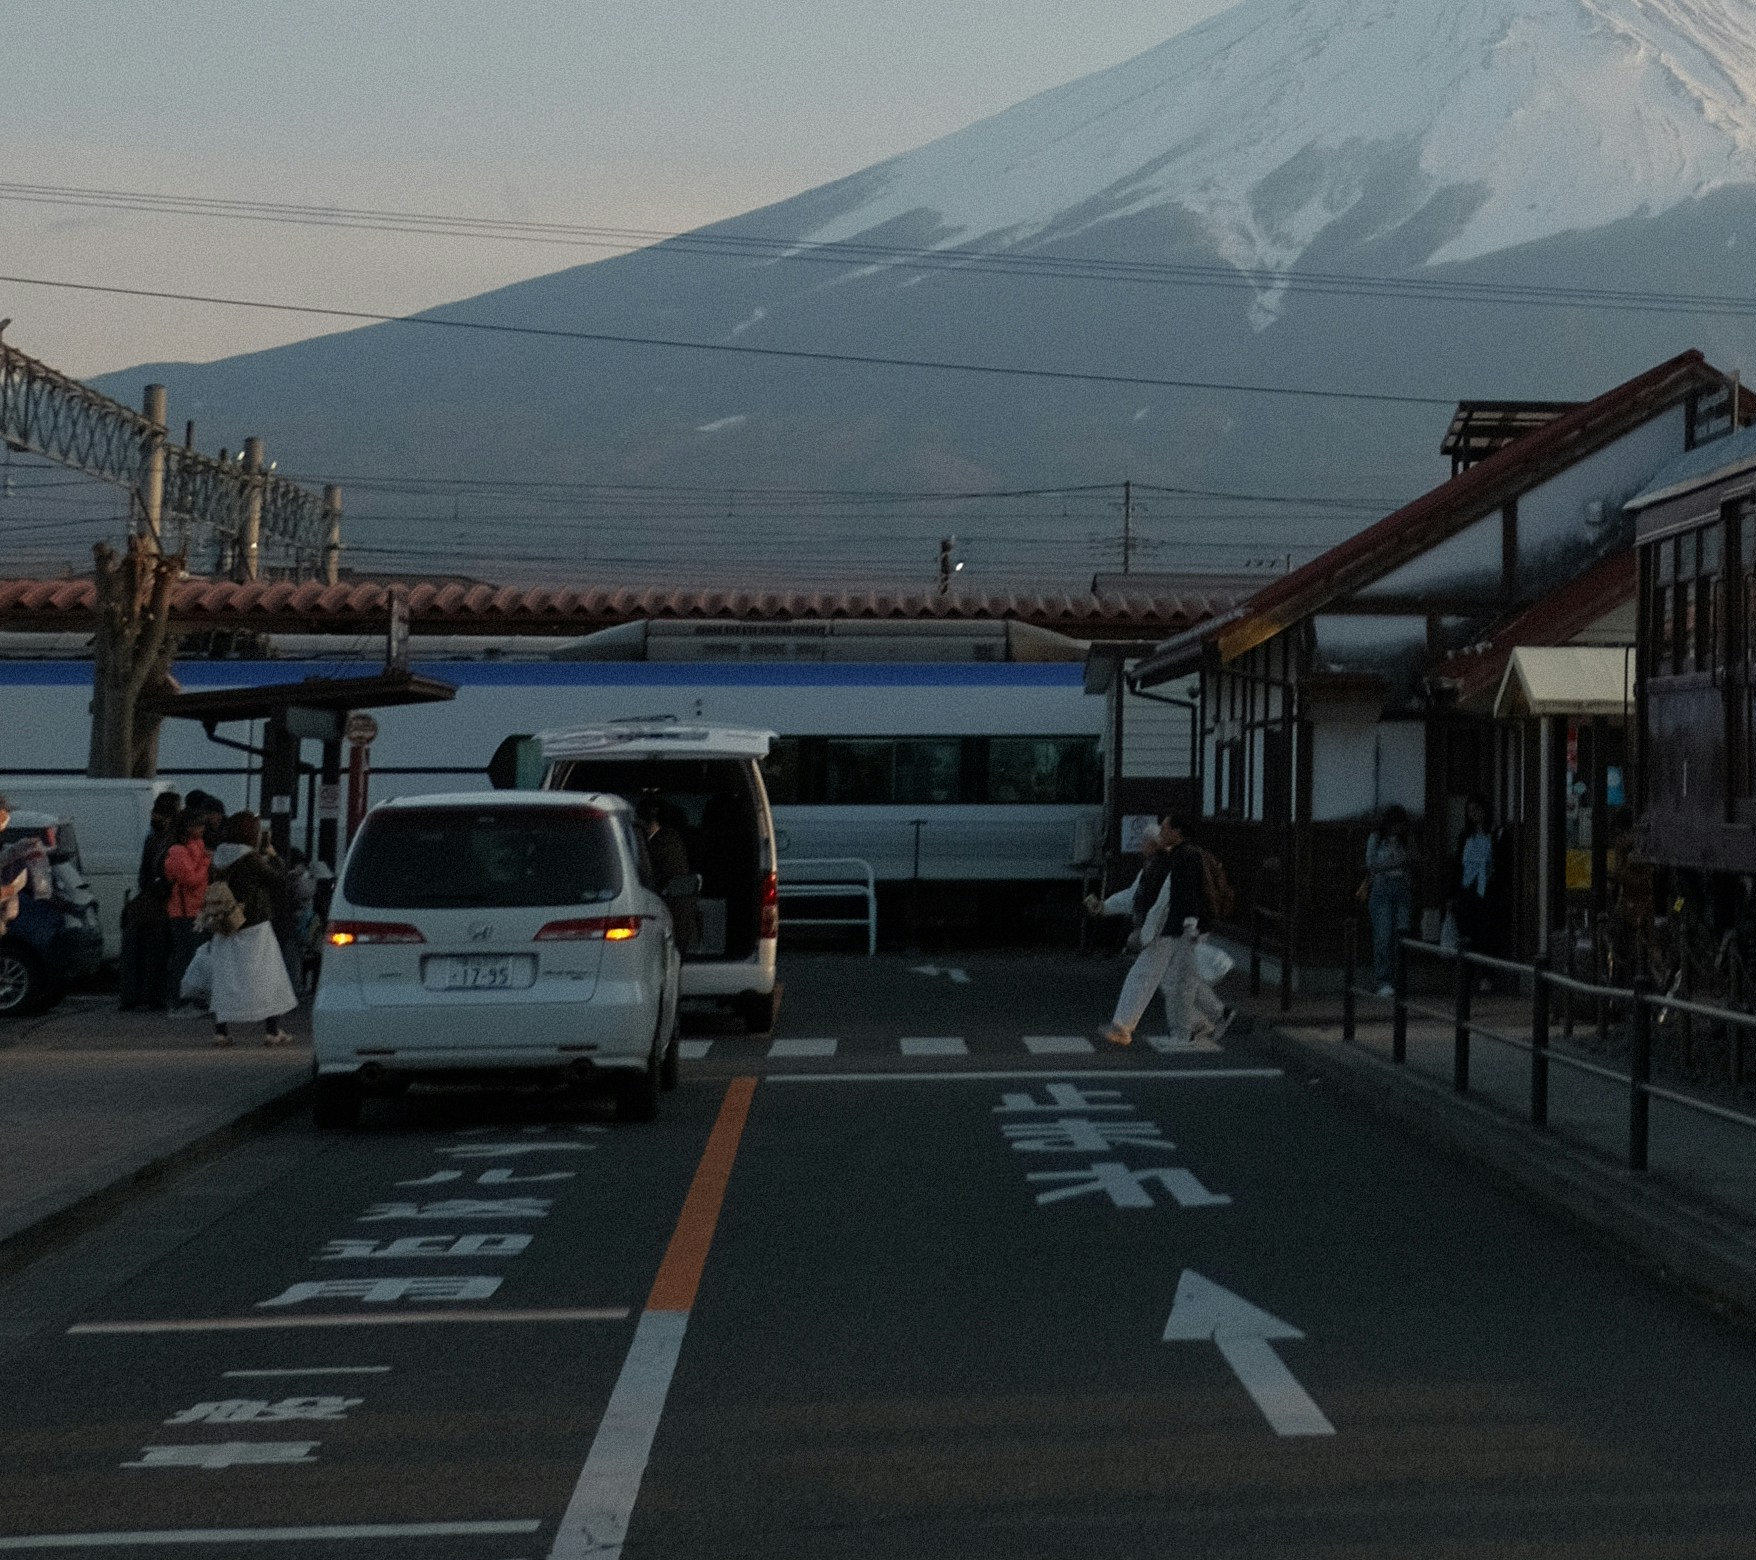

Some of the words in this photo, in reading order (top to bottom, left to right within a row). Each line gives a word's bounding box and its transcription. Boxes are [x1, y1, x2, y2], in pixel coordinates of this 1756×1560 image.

[991, 1083, 1234, 1208] 止まれ
[118, 1365, 393, 1469] 一般車
